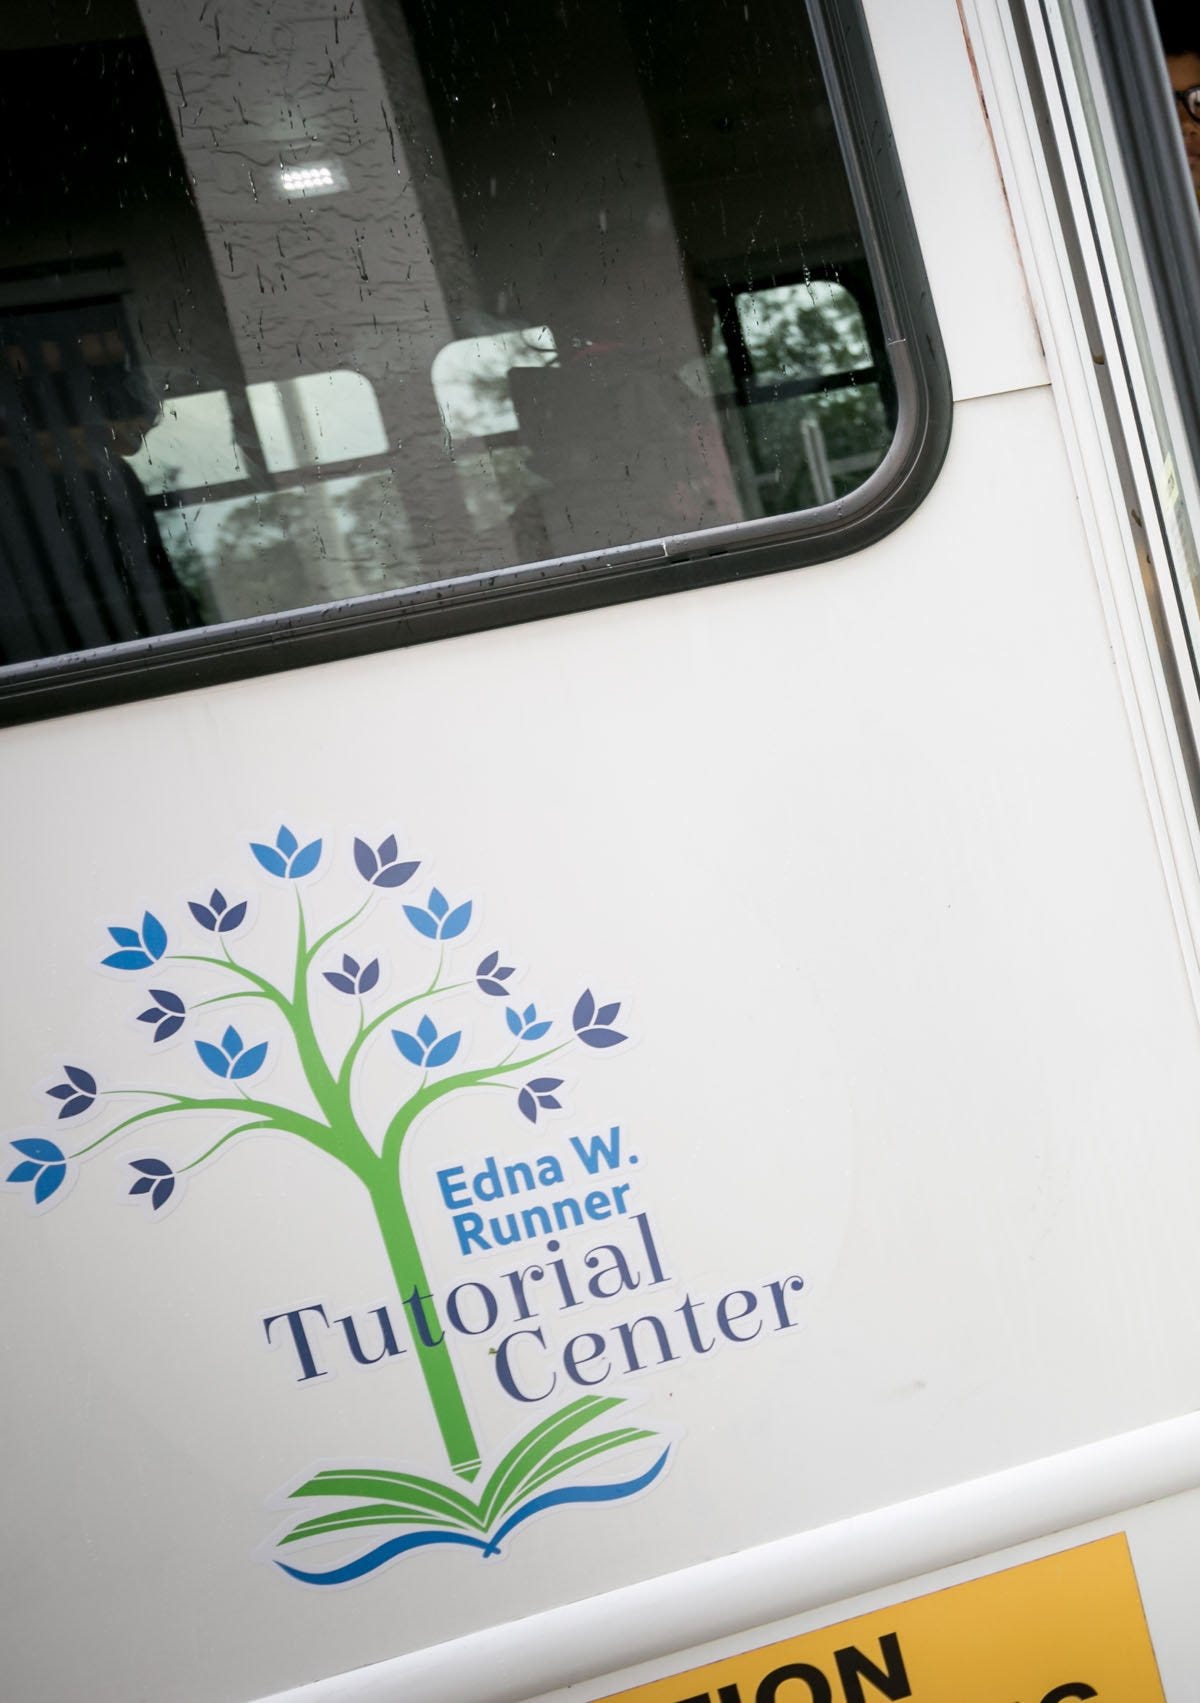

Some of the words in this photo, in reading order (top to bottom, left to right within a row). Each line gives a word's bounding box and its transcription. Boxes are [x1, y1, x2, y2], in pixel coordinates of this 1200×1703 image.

[436, 1156, 564, 1210] Edna
[569, 1126, 639, 1175] W.
[451, 1182, 631, 1256] Runner
[262, 1211, 672, 1383] Tutorial
[494, 1274, 804, 1403] Center
